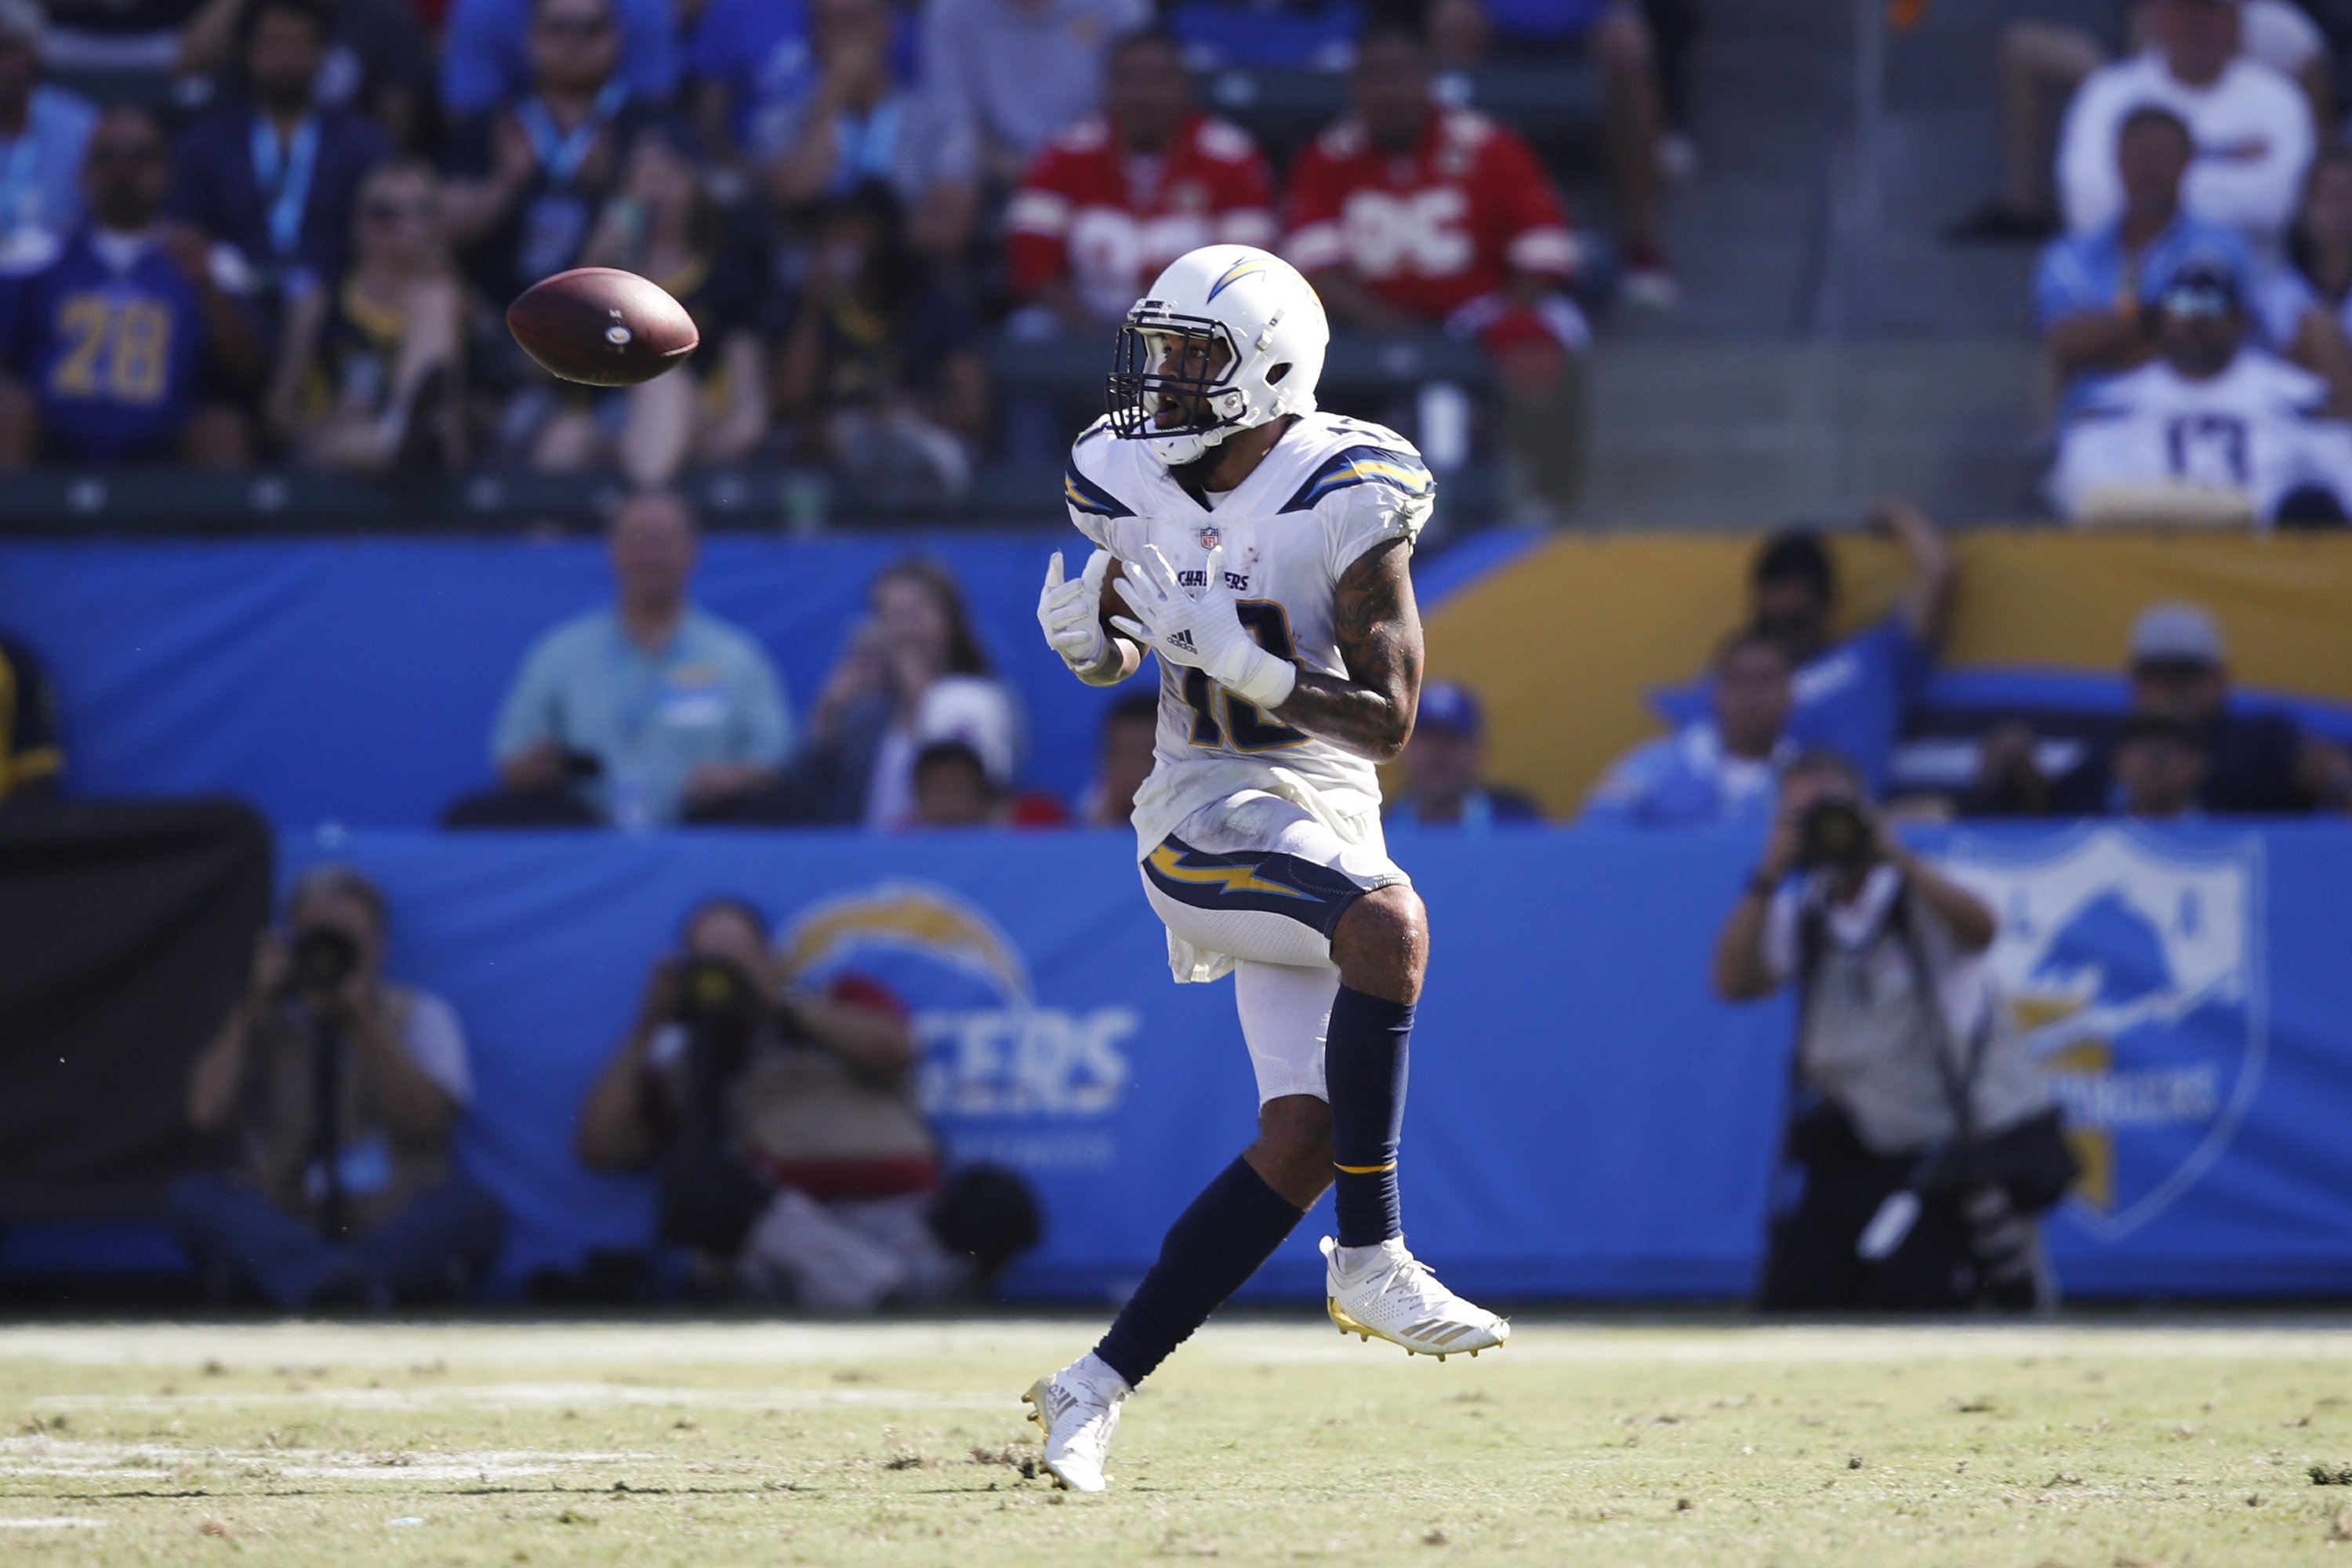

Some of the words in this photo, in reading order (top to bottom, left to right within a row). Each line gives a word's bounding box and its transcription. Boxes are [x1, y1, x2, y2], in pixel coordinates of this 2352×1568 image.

[55, 293, 171, 402] 28
[1202, 535, 1218, 547] NFL
[1178, 570, 1249, 591] CHAERS
[1166, 636, 1198, 655] adidas
[912, 1008, 1138, 1113] GERS
